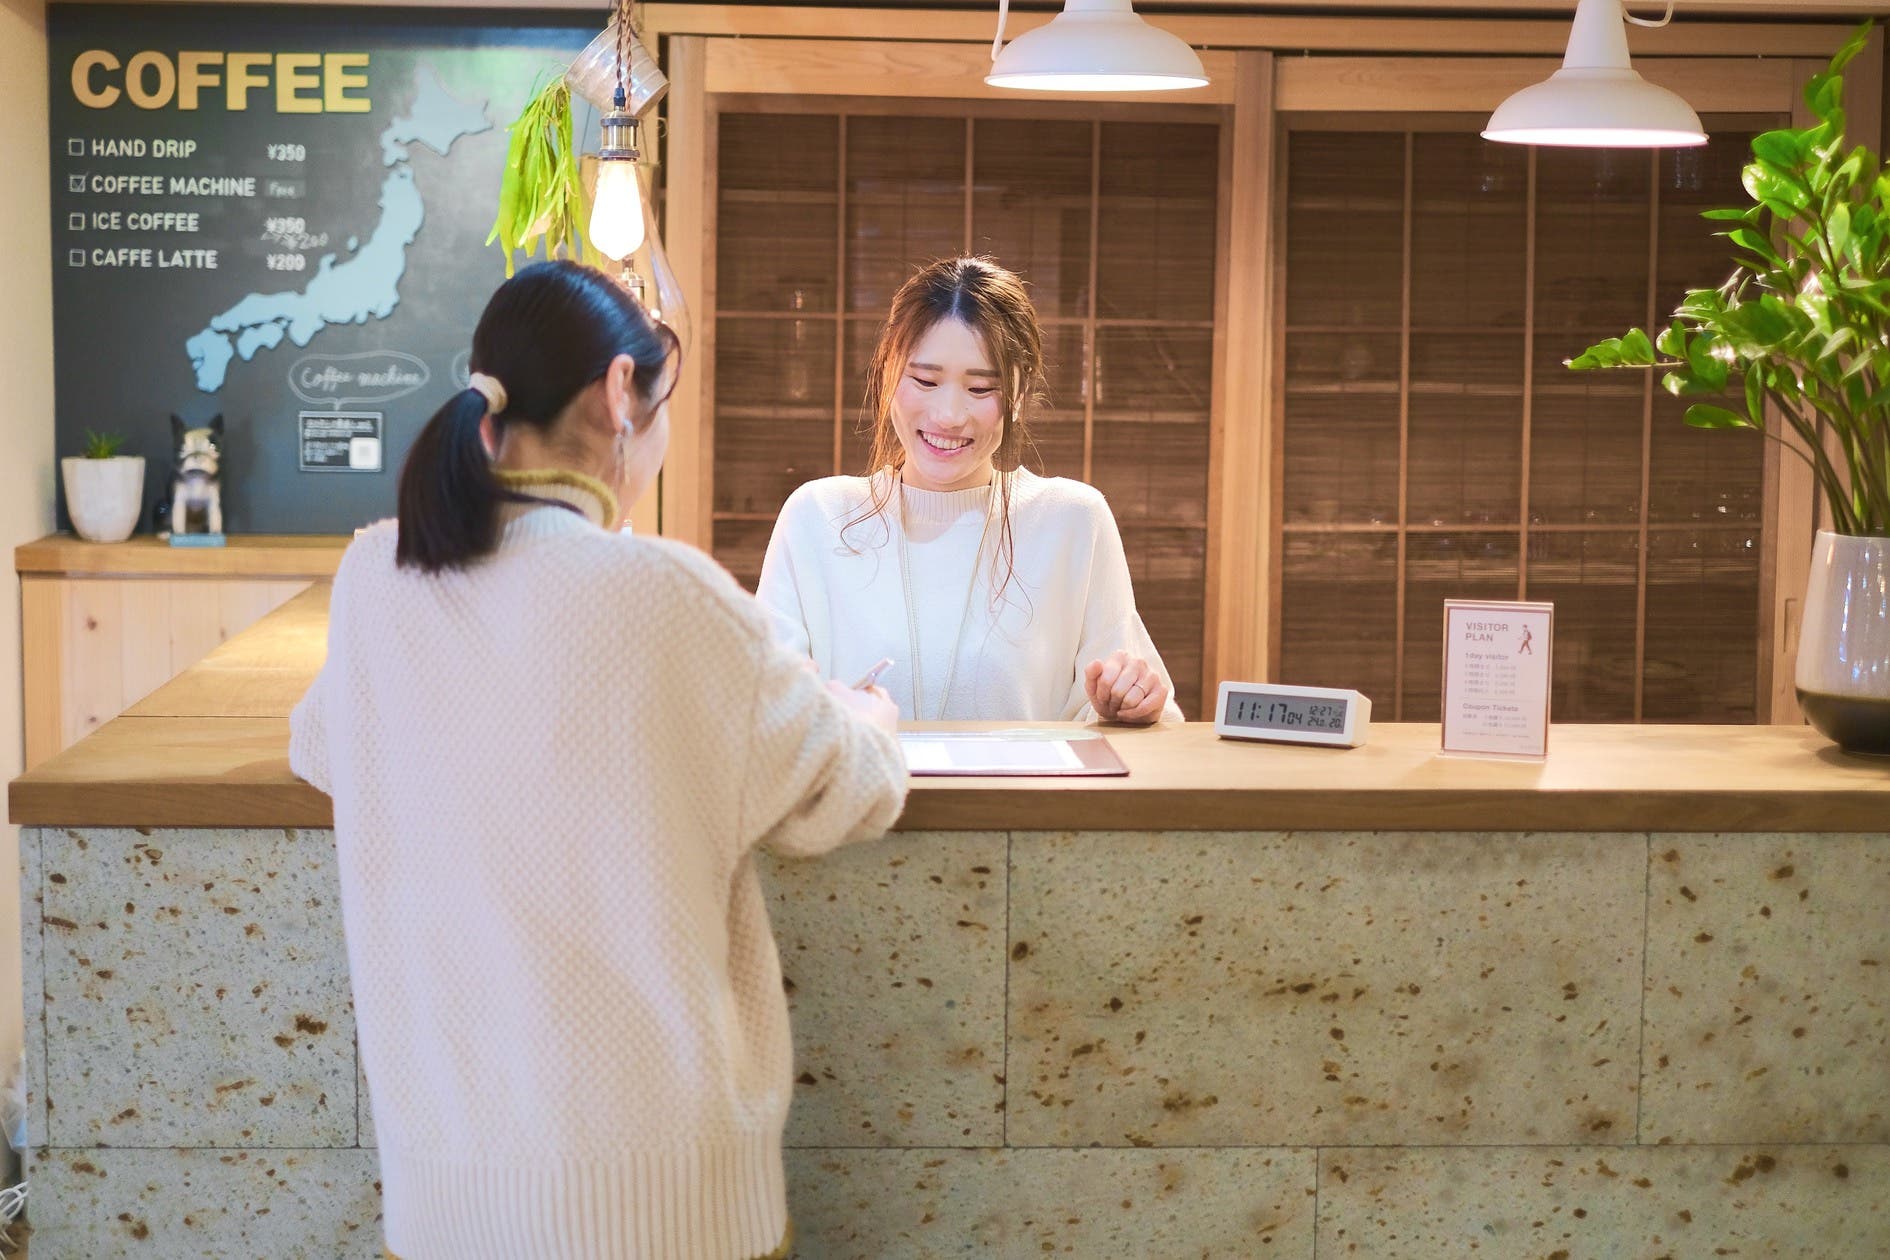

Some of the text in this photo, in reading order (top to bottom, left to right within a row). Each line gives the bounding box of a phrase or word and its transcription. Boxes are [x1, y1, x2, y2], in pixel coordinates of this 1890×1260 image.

[71, 50, 371, 113] COFFEE
[92, 139, 146, 157] HAND
[153, 140, 197, 158] DRIP
[92, 176, 164, 195] COFFEE
[170, 177, 256, 196] MACHINE
[92, 212, 121, 230] ICE
[127, 213, 200, 232] COFFEE
[92, 248, 152, 267] CAFFE
[159, 249, 218, 269] LATTE
[302, 364, 420, 392] Coffee machine
[1465, 632, 1494, 642] PLAN
[1466, 622, 1509, 632] VISITOR
[1236, 701, 1288, 723] 11:17
